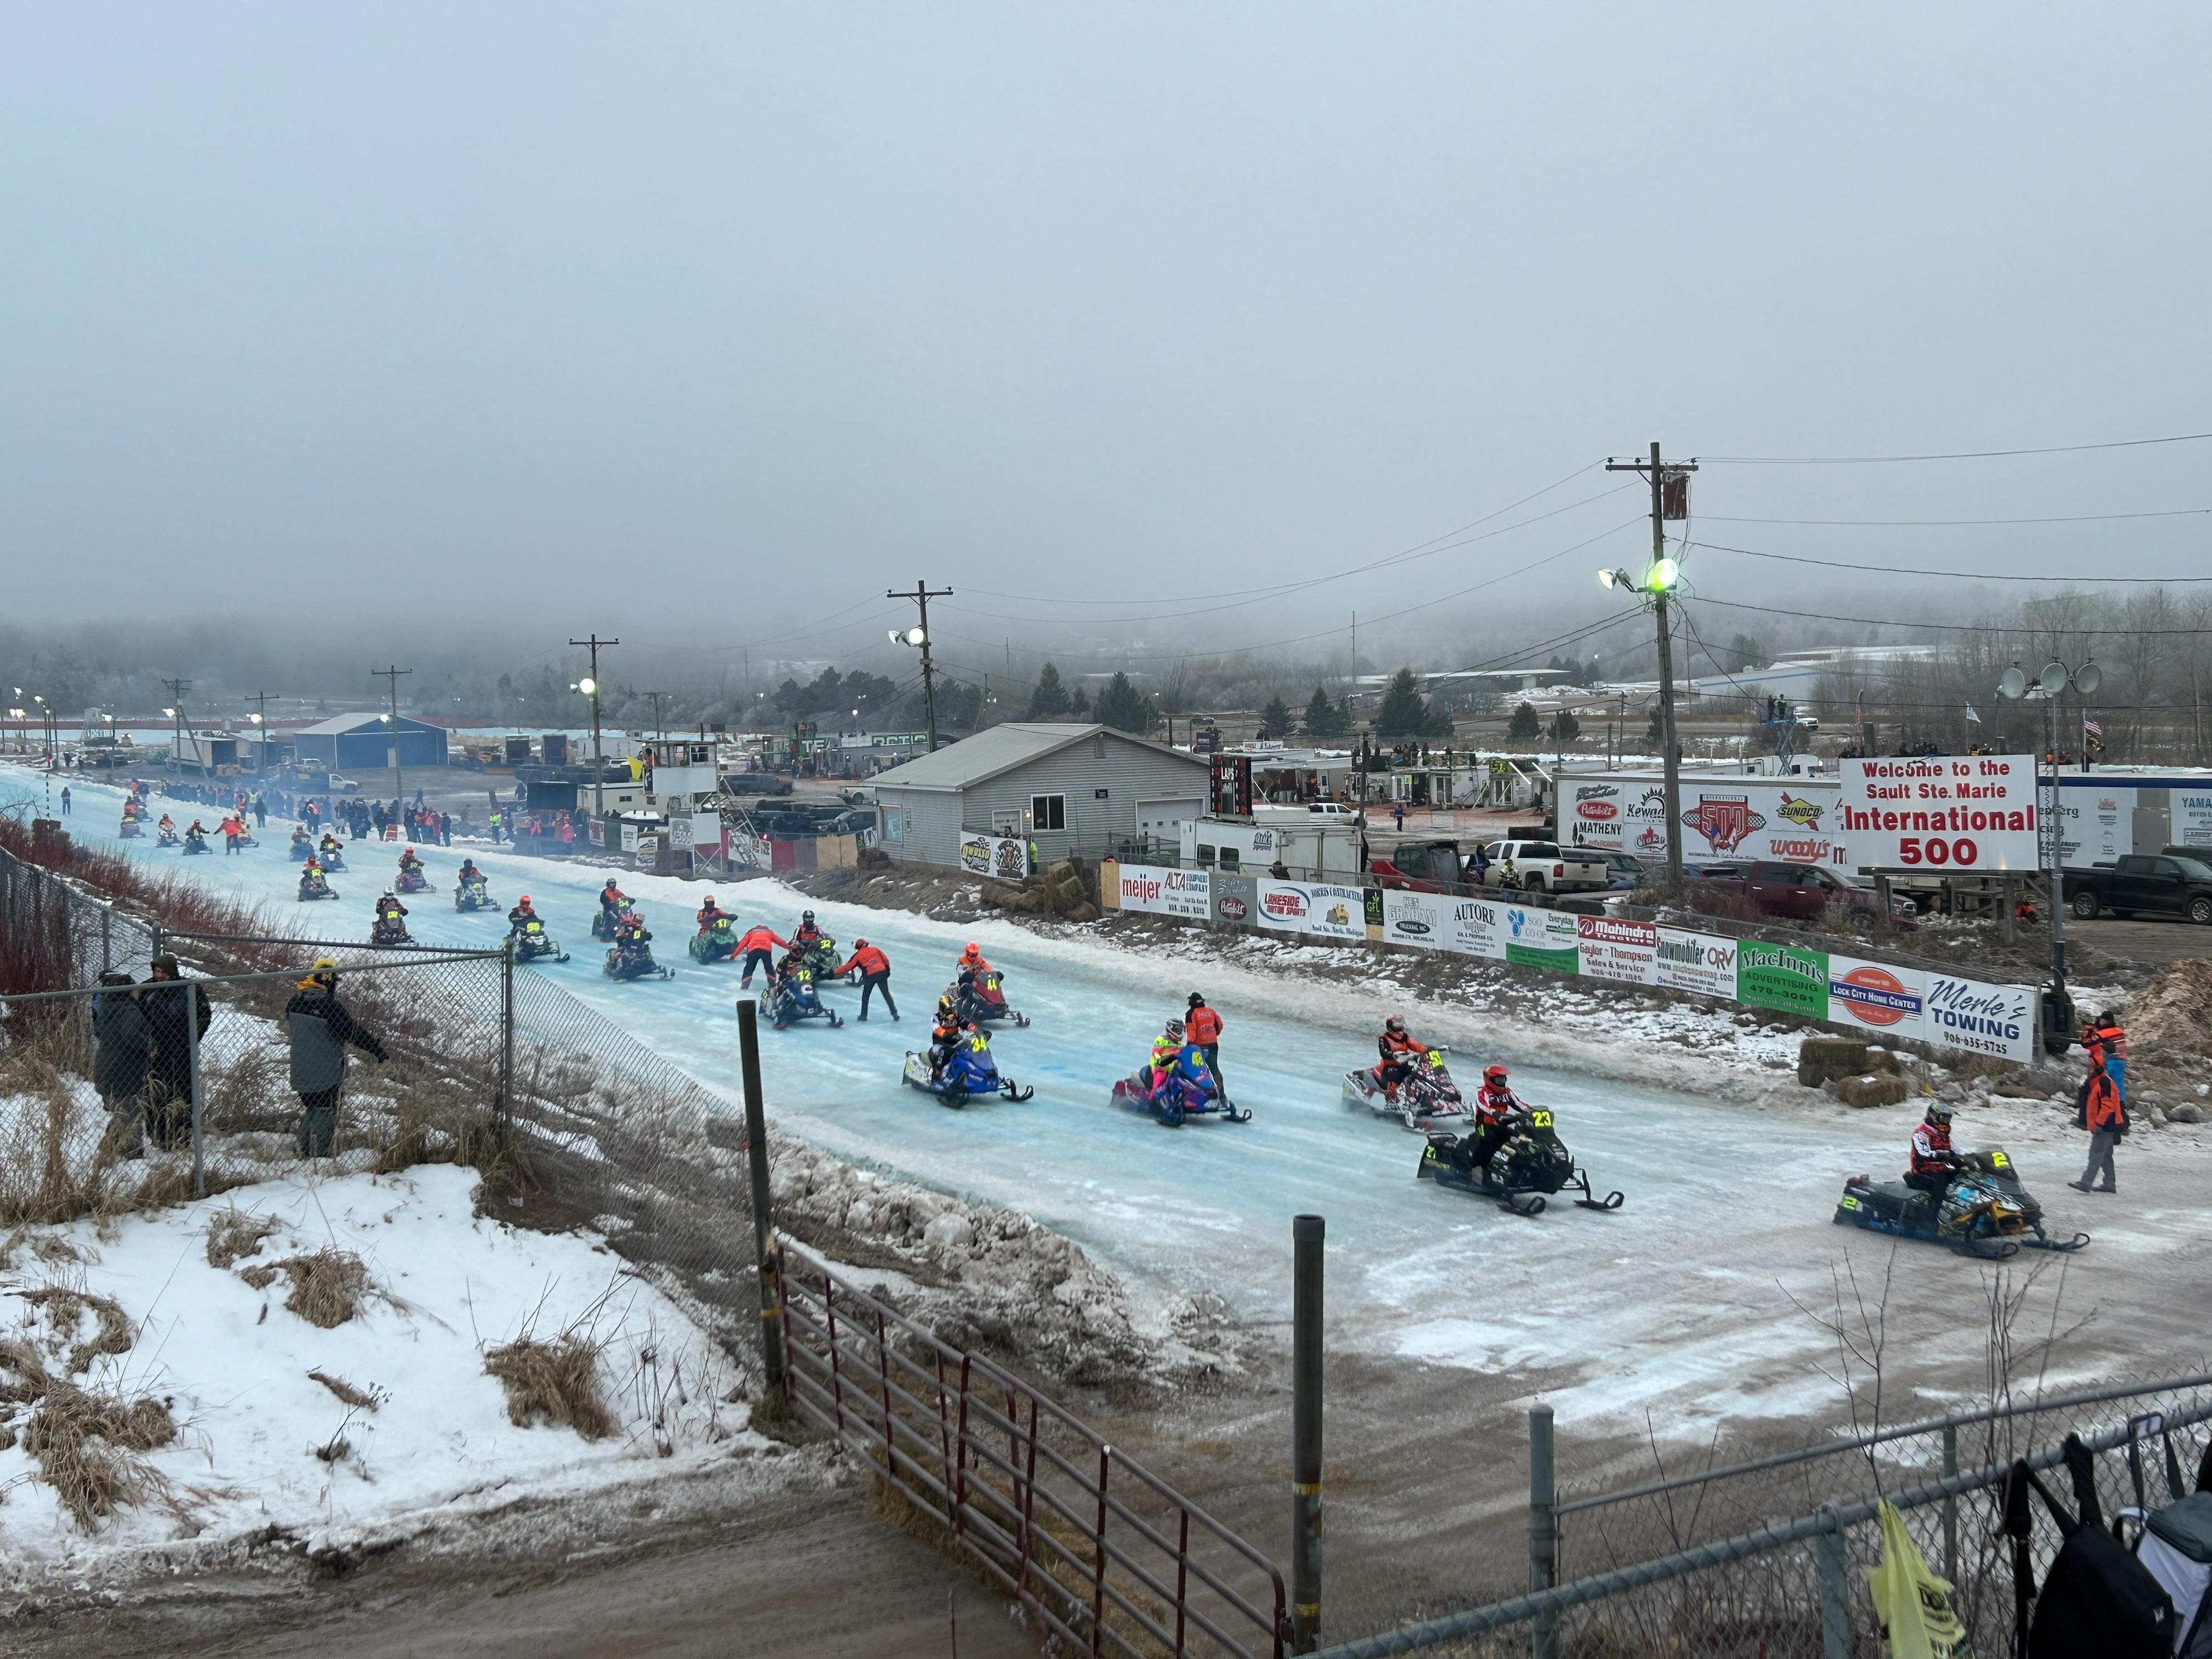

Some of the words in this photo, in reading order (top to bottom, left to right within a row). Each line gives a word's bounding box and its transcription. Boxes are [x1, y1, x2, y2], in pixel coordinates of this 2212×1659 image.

[1862, 762, 1943, 778] Welcome
[1952, 761, 1970, 777] to
[1979, 760, 2010, 776] the
[1866, 783, 1911, 799] Sault
[1919, 784, 1952, 799] Ste.
[1956, 782, 2007, 799] Marie
[1627, 804, 1666, 819] Kewad
[1780, 807, 1820, 817] SUNOCO
[1844, 806, 2035, 831] International
[1579, 822, 1622, 835] MATHENY
[1900, 838, 1978, 865] 500
[1122, 873, 1161, 904] meijer
[1164, 872, 1185, 891] ALTA
[1454, 903, 1496, 925] AUTORE
[1595, 921, 1654, 939] Mahindra
[1610, 947, 1653, 963] Thompson
[1656, 936, 1705, 966] Snowmobiler
[1707, 947, 1736, 971] ORV
[1587, 958, 1607, 968] Sales
[1616, 962, 1645, 973] Service
[1741, 948, 1824, 985] MacInnis
[797, 970, 811, 982] 12
[1746, 972, 1818, 992] ADVERTISING
[1833, 985, 1850, 996] LOCK
[1852, 988, 1867, 1000] CITY
[1868, 992, 1888, 1004] HOME
[1889, 996, 1916, 1009] CENTER
[1927, 980, 2027, 1020] Merle's
[1931, 1007, 2020, 1040] TOWING
[971, 1035, 987, 1053] 34
[1944, 1031, 2007, 1054] 906-635-5725
[1533, 1111, 1551, 1127] 23
